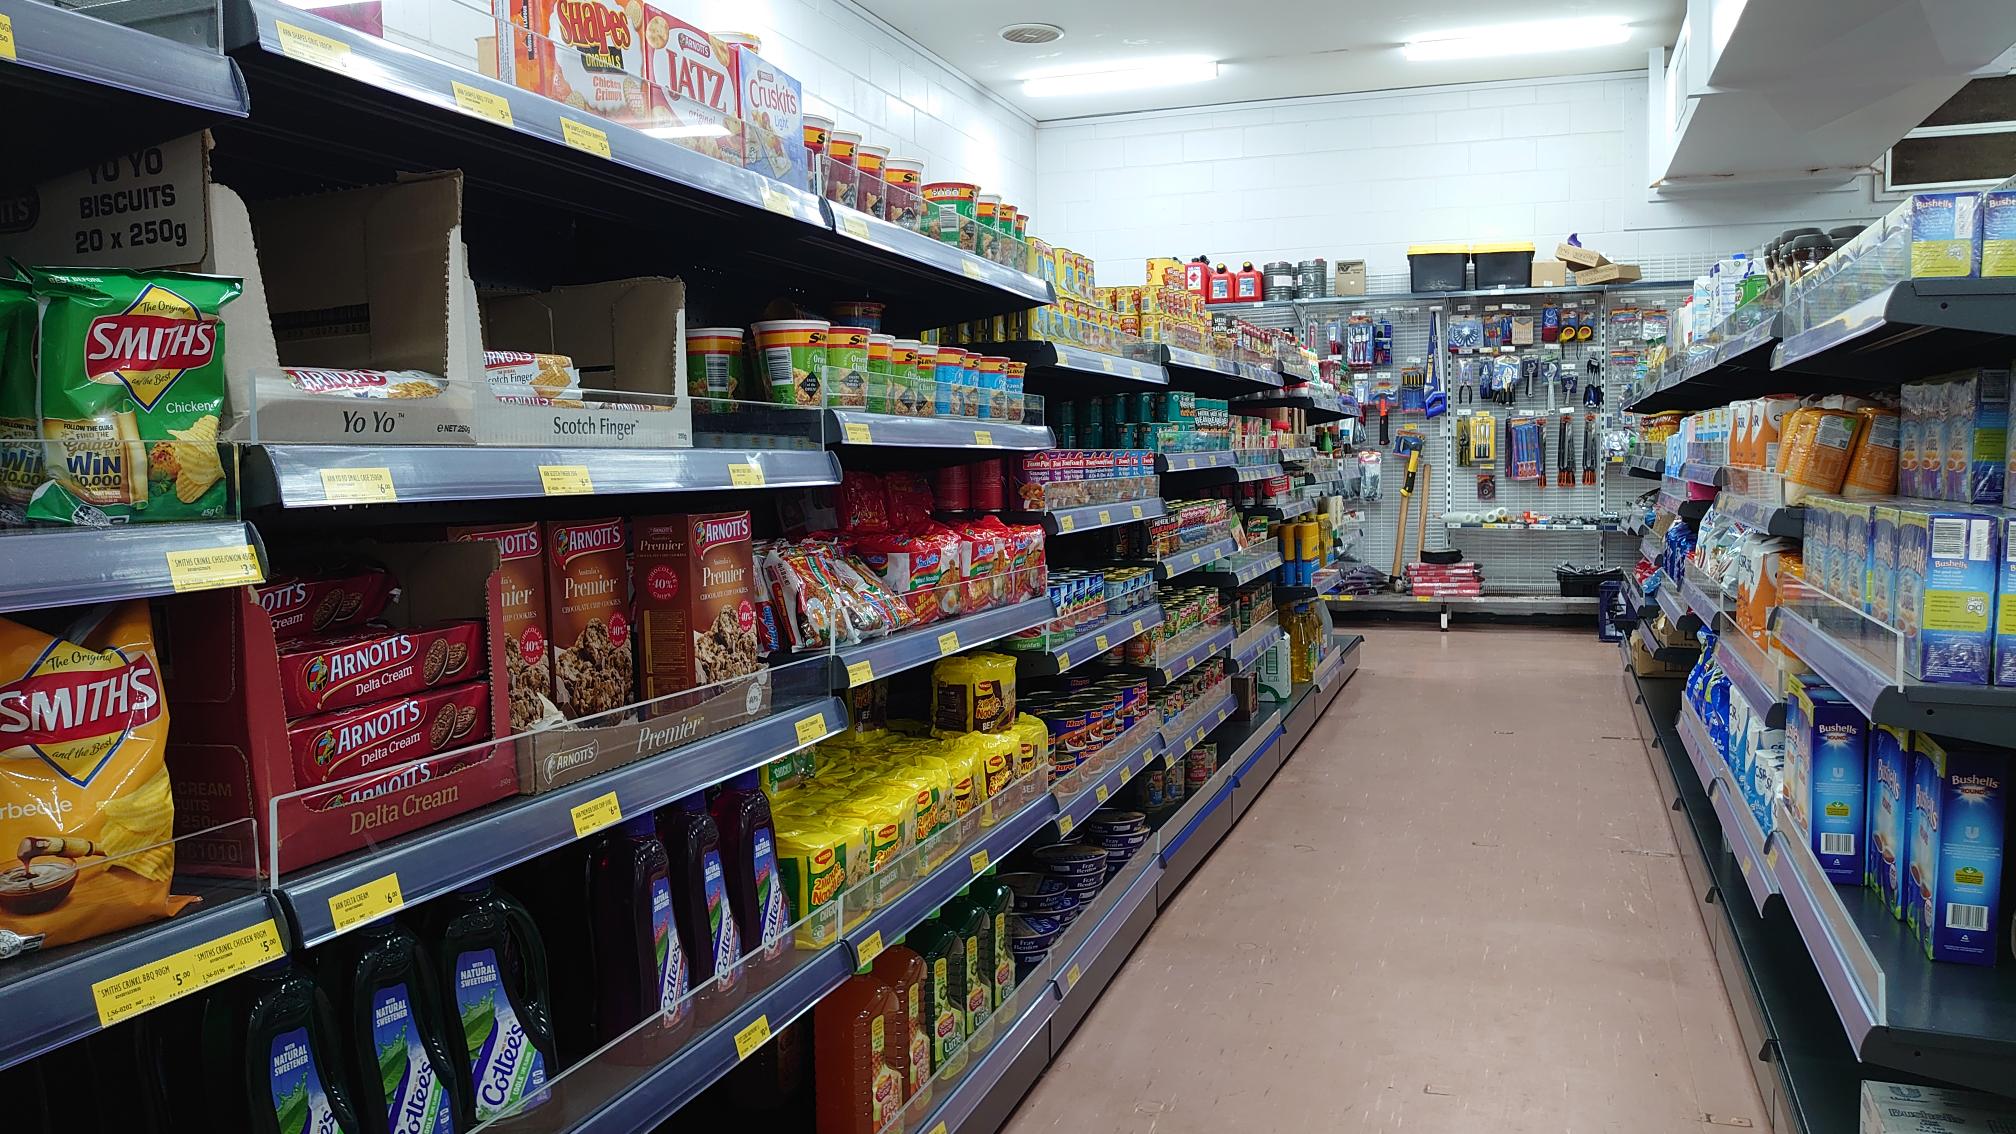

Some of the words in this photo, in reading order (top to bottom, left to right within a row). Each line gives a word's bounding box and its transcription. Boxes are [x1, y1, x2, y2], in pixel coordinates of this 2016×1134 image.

[666, 49, 727, 112] JATZ
[749, 78, 797, 115] Cruskits
[128, 147, 163, 178] YO
[79, 184, 176, 219] BISCUITS
[1916, 199, 1953, 210] Bushells
[75, 228, 103, 254] 20
[111, 232, 123, 249] x
[129, 218, 188, 247] 250g
[140, 301, 157, 313] The
[158, 299, 191, 315] Original
[153, 372, 171, 386] Best
[510, 373, 533, 384] Finger
[166, 401, 212, 414] Chicken
[63, 423, 85, 432] FOLLOW
[342, 410, 366, 434] Yo
[373, 410, 396, 434] Yo
[444, 424, 457, 433] NET
[552, 415, 597, 435] Scotch
[599, 415, 637, 438] Finger
[75, 431, 95, 440] FIND
[569, 525, 621, 551] ARNOTT'S
[705, 519, 748, 542] ARNOTT'S
[640, 540, 683, 551] Premier
[702, 564, 745, 587] Premier
[1934, 560, 1969, 569] Bushells
[565, 574, 616, 599] Premier
[653, 578, 673, 589] 40%
[561, 604, 592, 615] CHOCOLATE
[523, 640, 541, 652] 40%
[46, 655, 69, 671] The
[71, 651, 115, 666] Original
[330, 634, 413, 682] ARNOTT'S
[355, 677, 380, 697] Delta
[381, 665, 413, 688] Cream
[0, 665, 158, 733] SMITH'S
[337, 699, 421, 754] ARNOTT'S
[636, 714, 703, 754] Premier
[1819, 723, 1858, 735] Bushells
[52, 747, 77, 761] and
[75, 743, 88, 758] the
[90, 735, 113, 755] Best
[361, 747, 388, 767] Delta
[388, 732, 421, 753] Cream
[556, 745, 594, 770] ARNOTT'S
[1951, 775, 2000, 789] Bushells
[350, 804, 399, 836] Delta
[402, 784, 459, 821] Cream
[197, 948, 216, 962] SMITHS
[233, 935, 253, 949] CHICKEN
[101, 984, 122, 998] SMITHS
[143, 971, 155, 982] BBQ
[460, 965, 496, 981] NATURAL
[460, 973, 497, 988] SWEETENER
[376, 999, 407, 1019] NATURAL
[376, 1009, 408, 1028] SWEETENER
[274, 1046, 307, 1067] NATURAL
[274, 1054, 309, 1077] SWEETENER
[482, 1023, 525, 1106] Cottee's
[398, 1061, 433, 1134] ottee's
